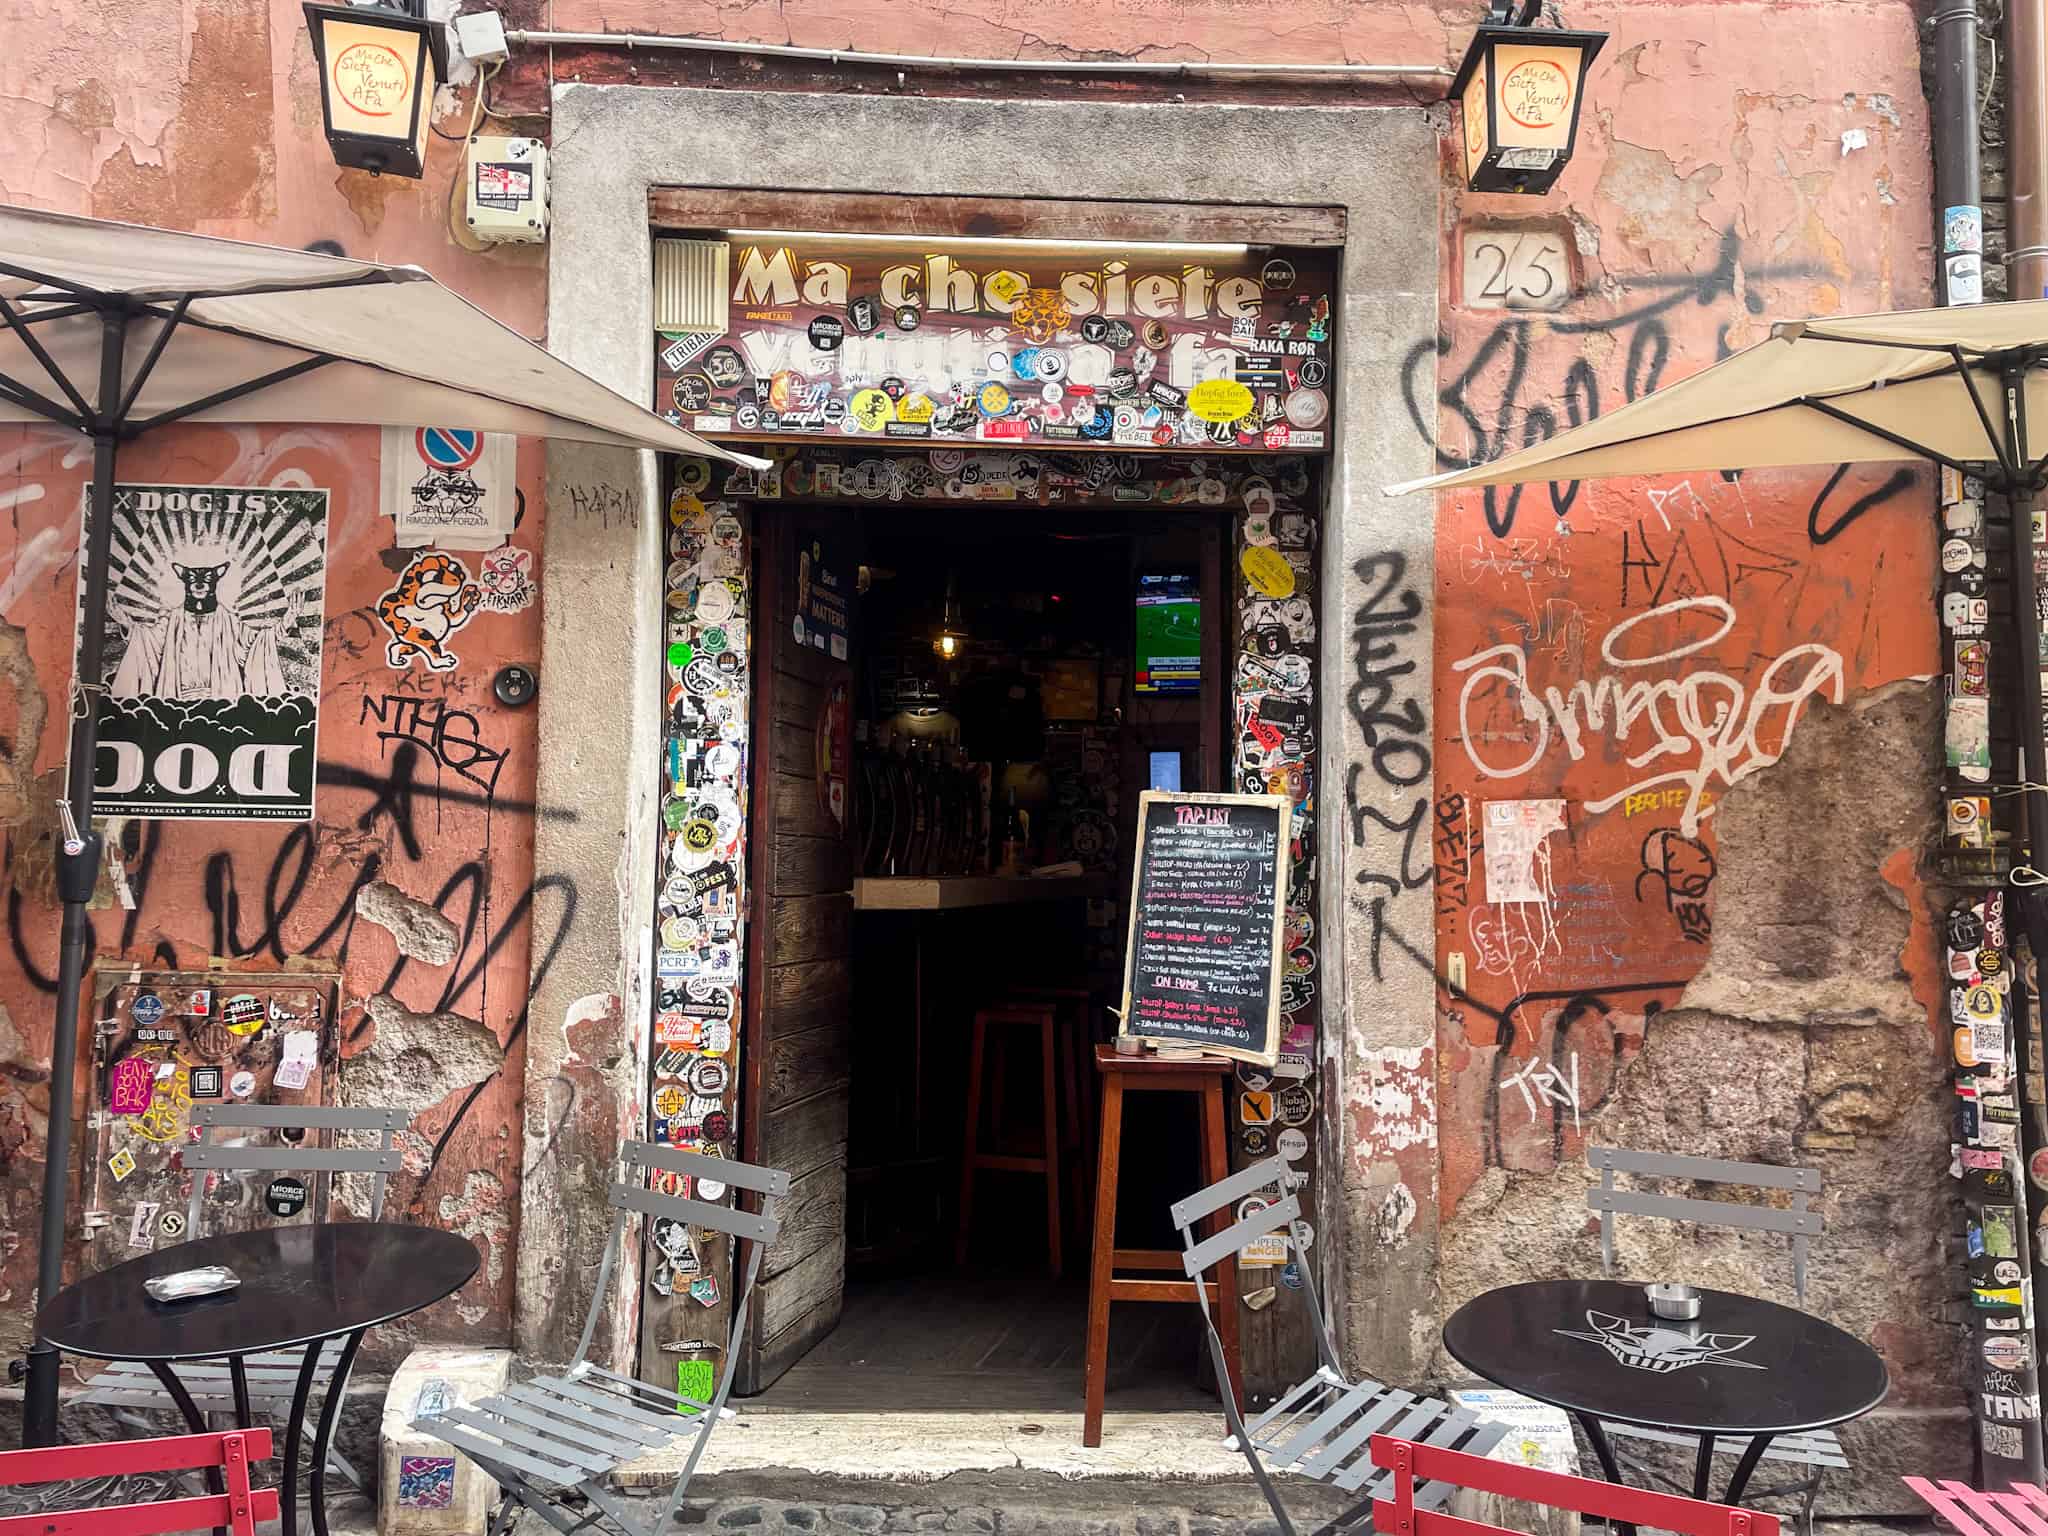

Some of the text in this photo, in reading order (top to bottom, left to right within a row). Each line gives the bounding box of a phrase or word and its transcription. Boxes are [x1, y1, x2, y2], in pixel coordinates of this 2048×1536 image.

[361, 72, 404, 91] Venuti
[1524, 90, 1564, 106] Venuti
[1474, 242, 1558, 299] 25
[733, 245, 1264, 320] Ma che siete
[1234, 317, 1256, 326] BON
[1250, 339, 1285, 354] RAKA
[136, 491, 266, 514] DOG IS
[453, 515, 489, 526] FORZATA
[1952, 624, 1985, 636] HEMP
[705, 872, 727, 885] FEST
[660, 958, 691, 968] PCRF
[1154, 975, 1171, 987] ON
[1174, 977, 1199, 991] PUMP
